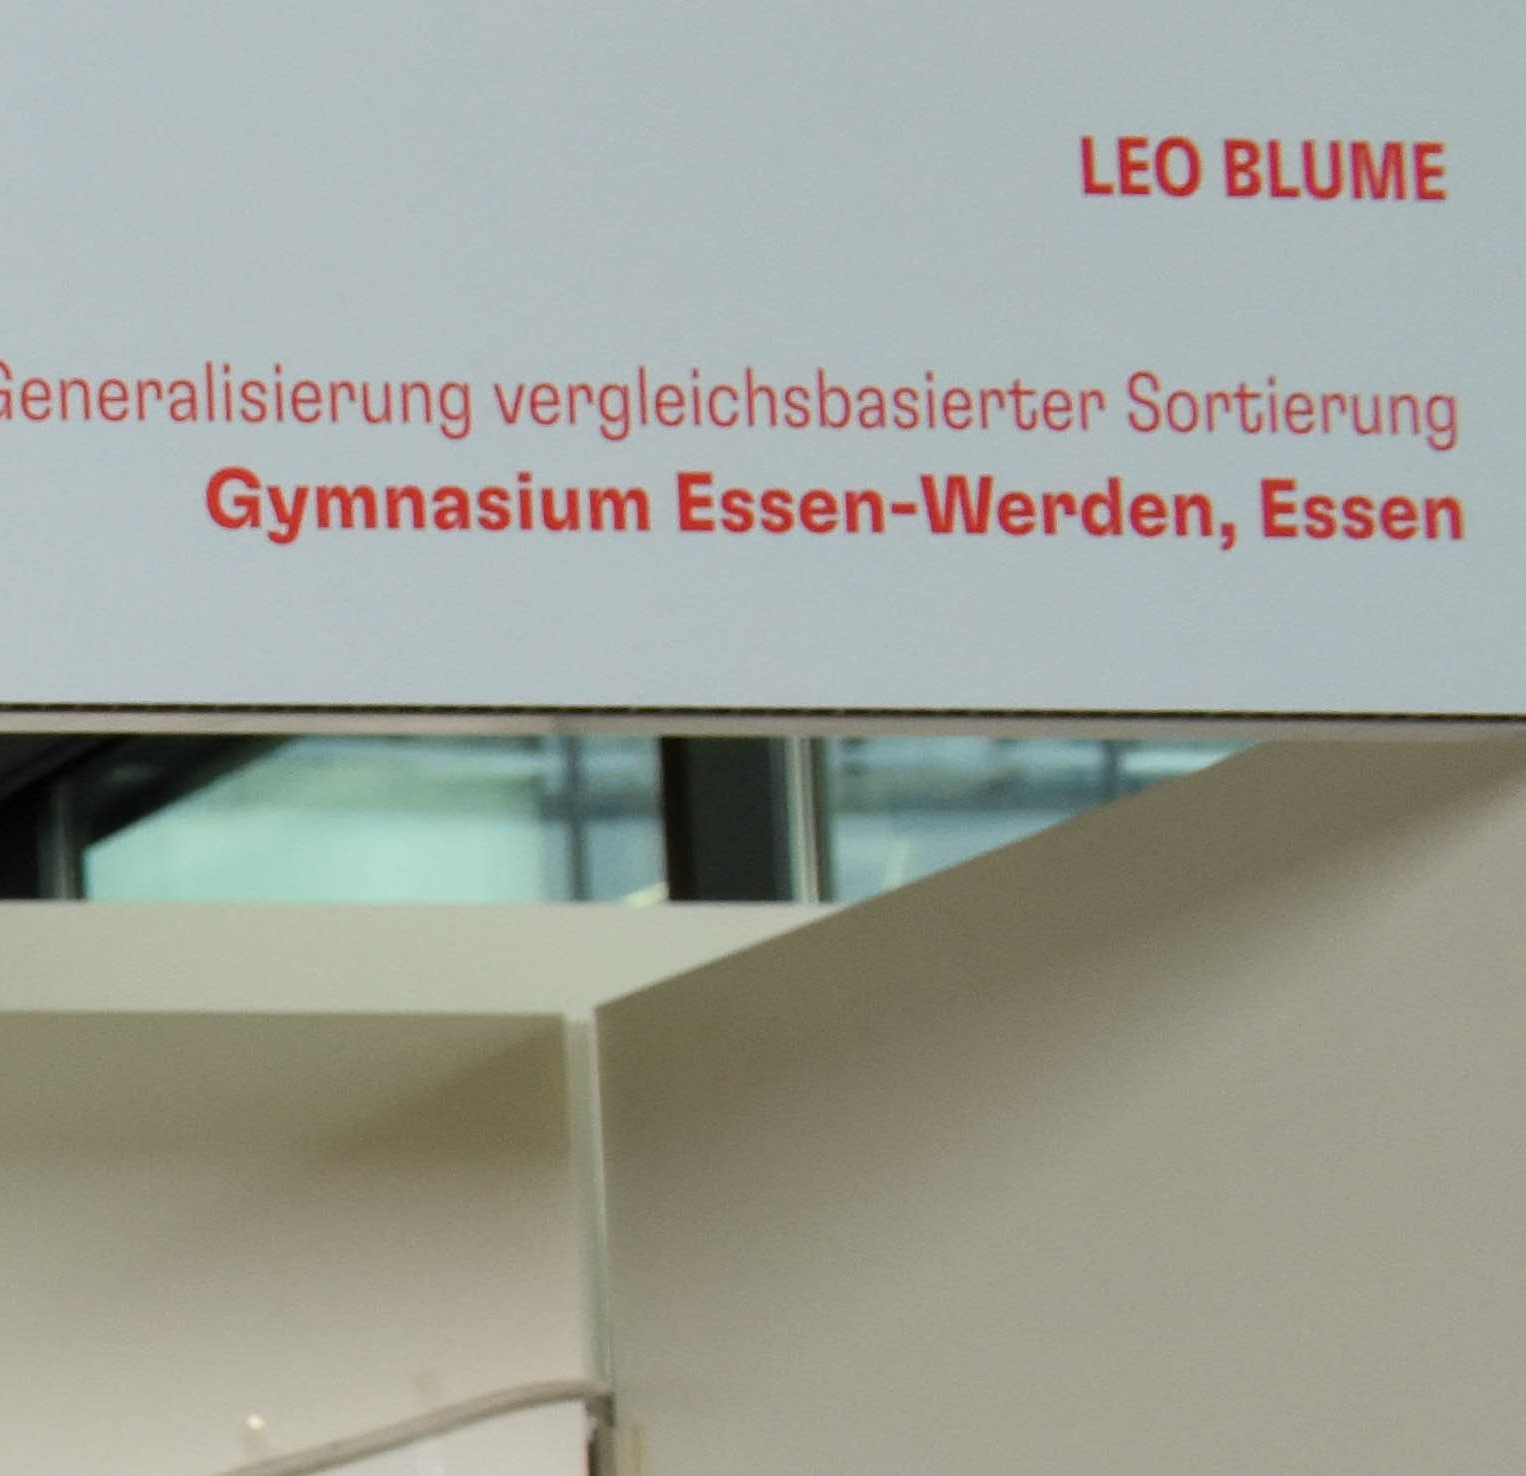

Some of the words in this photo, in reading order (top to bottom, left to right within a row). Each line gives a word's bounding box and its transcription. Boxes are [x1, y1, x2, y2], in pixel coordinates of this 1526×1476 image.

[1081, 135, 1203, 198] LEO
[1224, 138, 1447, 201] BLUME
[493, 367, 1107, 443] vergleichsbasierter
[1127, 369, 1458, 452] Sortierung
[206, 465, 651, 545] Gymnasium
[677, 471, 1237, 550] Essen-Werden,
[1260, 478, 1464, 540] Essen
